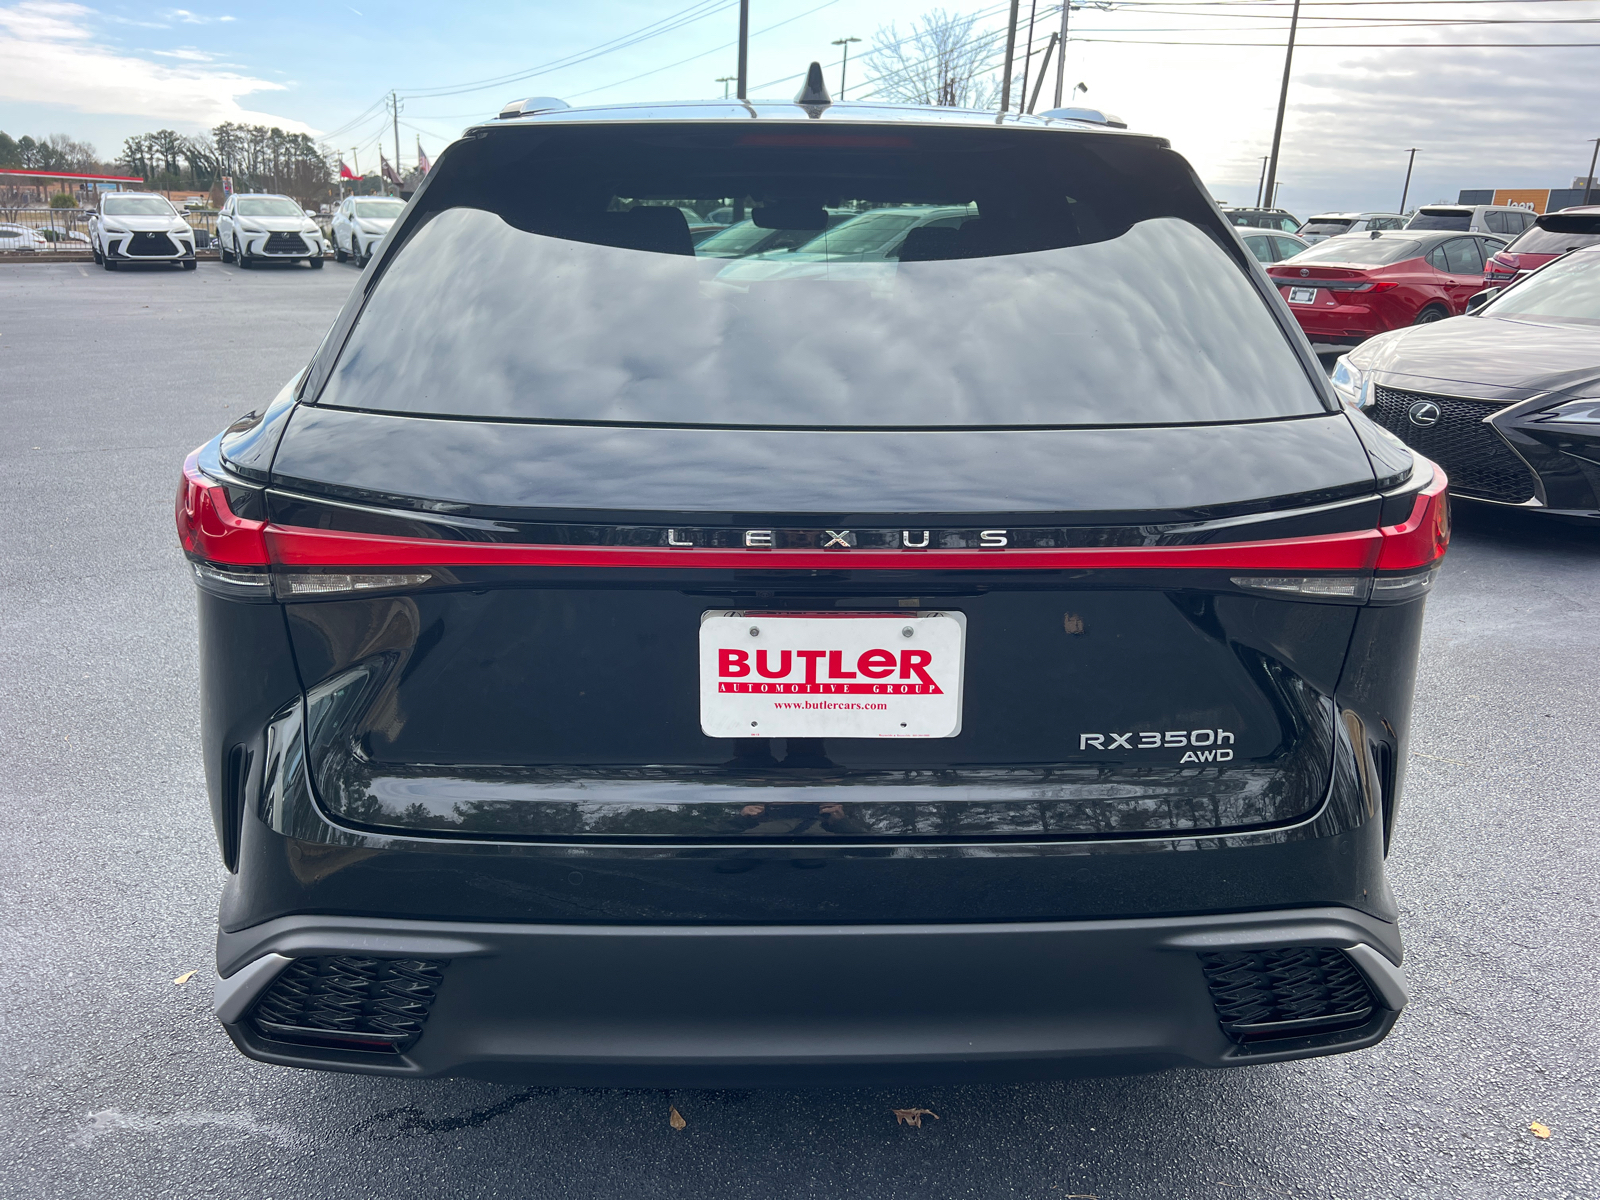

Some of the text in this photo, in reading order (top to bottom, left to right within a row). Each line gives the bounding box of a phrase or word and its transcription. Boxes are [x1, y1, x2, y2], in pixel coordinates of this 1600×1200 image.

[668, 529, 1008, 548] LEXUS
[718, 648, 937, 683] BUTLER
[719, 683, 936, 694] AUTOMOTIVE GROUP
[774, 700, 888, 711] www.butlercars.com
[1179, 749, 1234, 764] AWD
